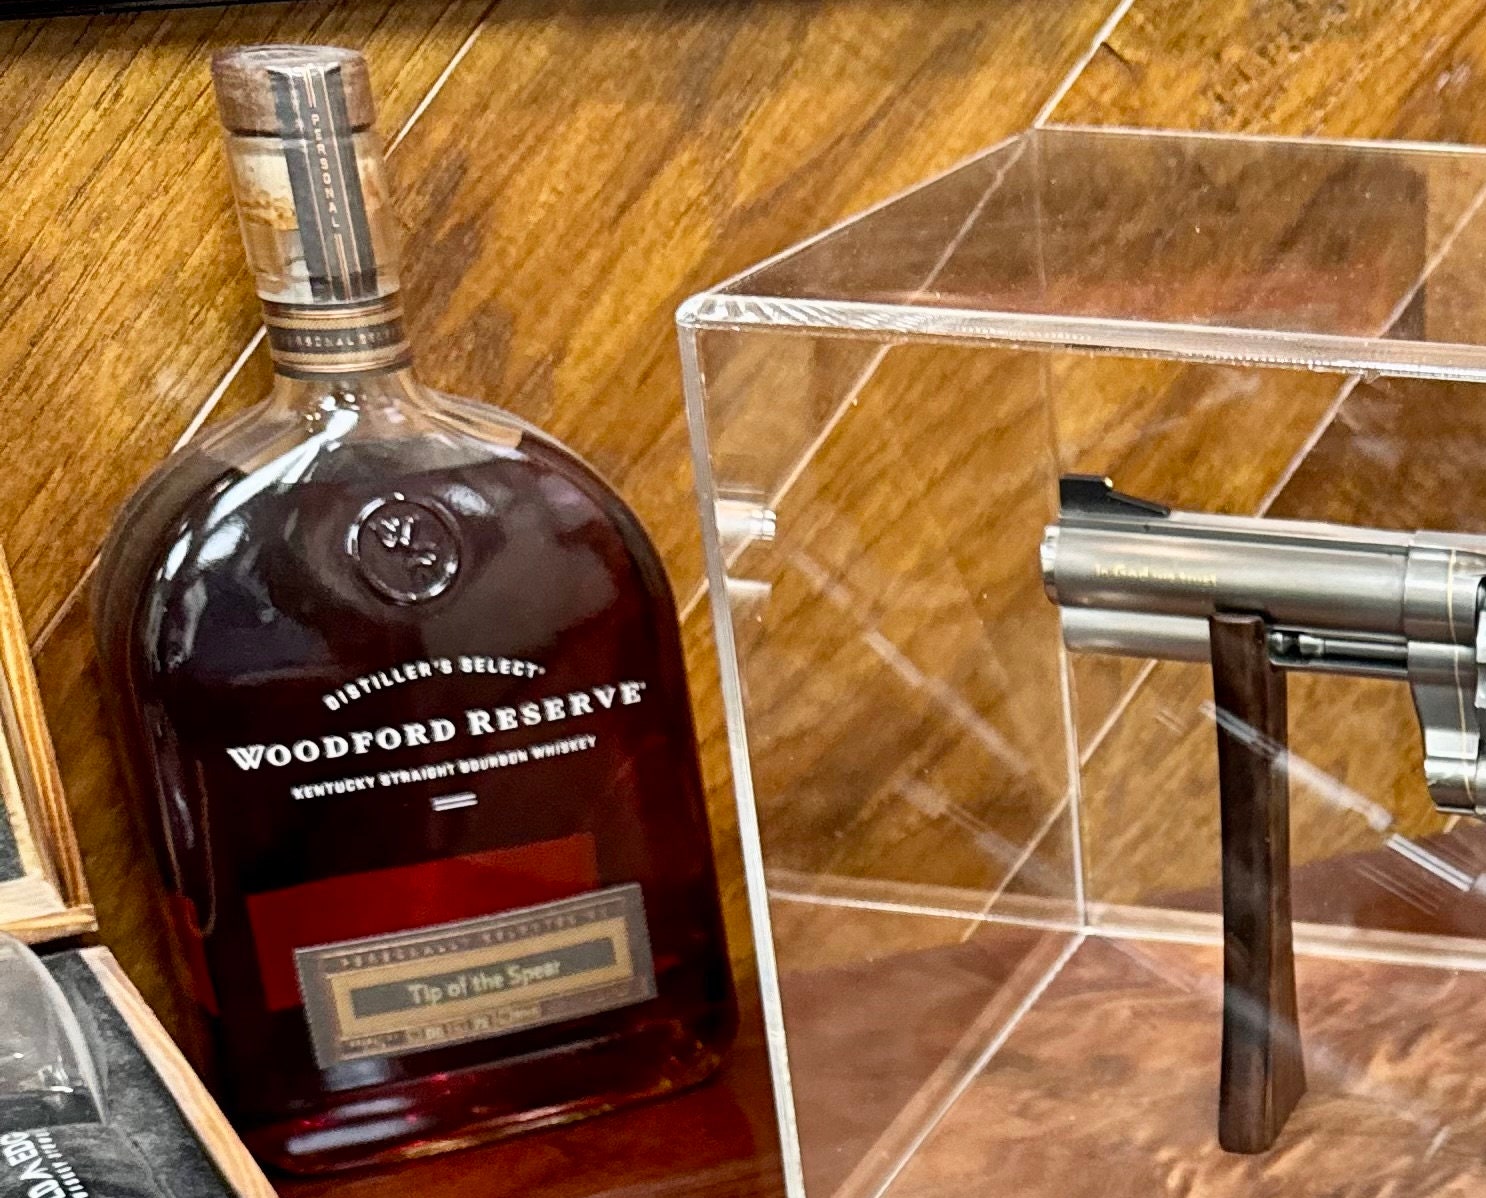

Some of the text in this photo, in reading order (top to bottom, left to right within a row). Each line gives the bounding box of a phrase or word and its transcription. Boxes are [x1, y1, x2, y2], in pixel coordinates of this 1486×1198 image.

[310, 112, 341, 229] PERSONAL
[322, 655, 541, 711] DISTILLER'S SELECT
[226, 679, 643, 771] WOODFORD RESERVE
[290, 733, 598, 800] KENTUCKY STRAIGHT BOURBON WHISKEY
[407, 983, 443, 1005] Tip
[446, 975, 468, 997] of
[470, 972, 505, 993] the
